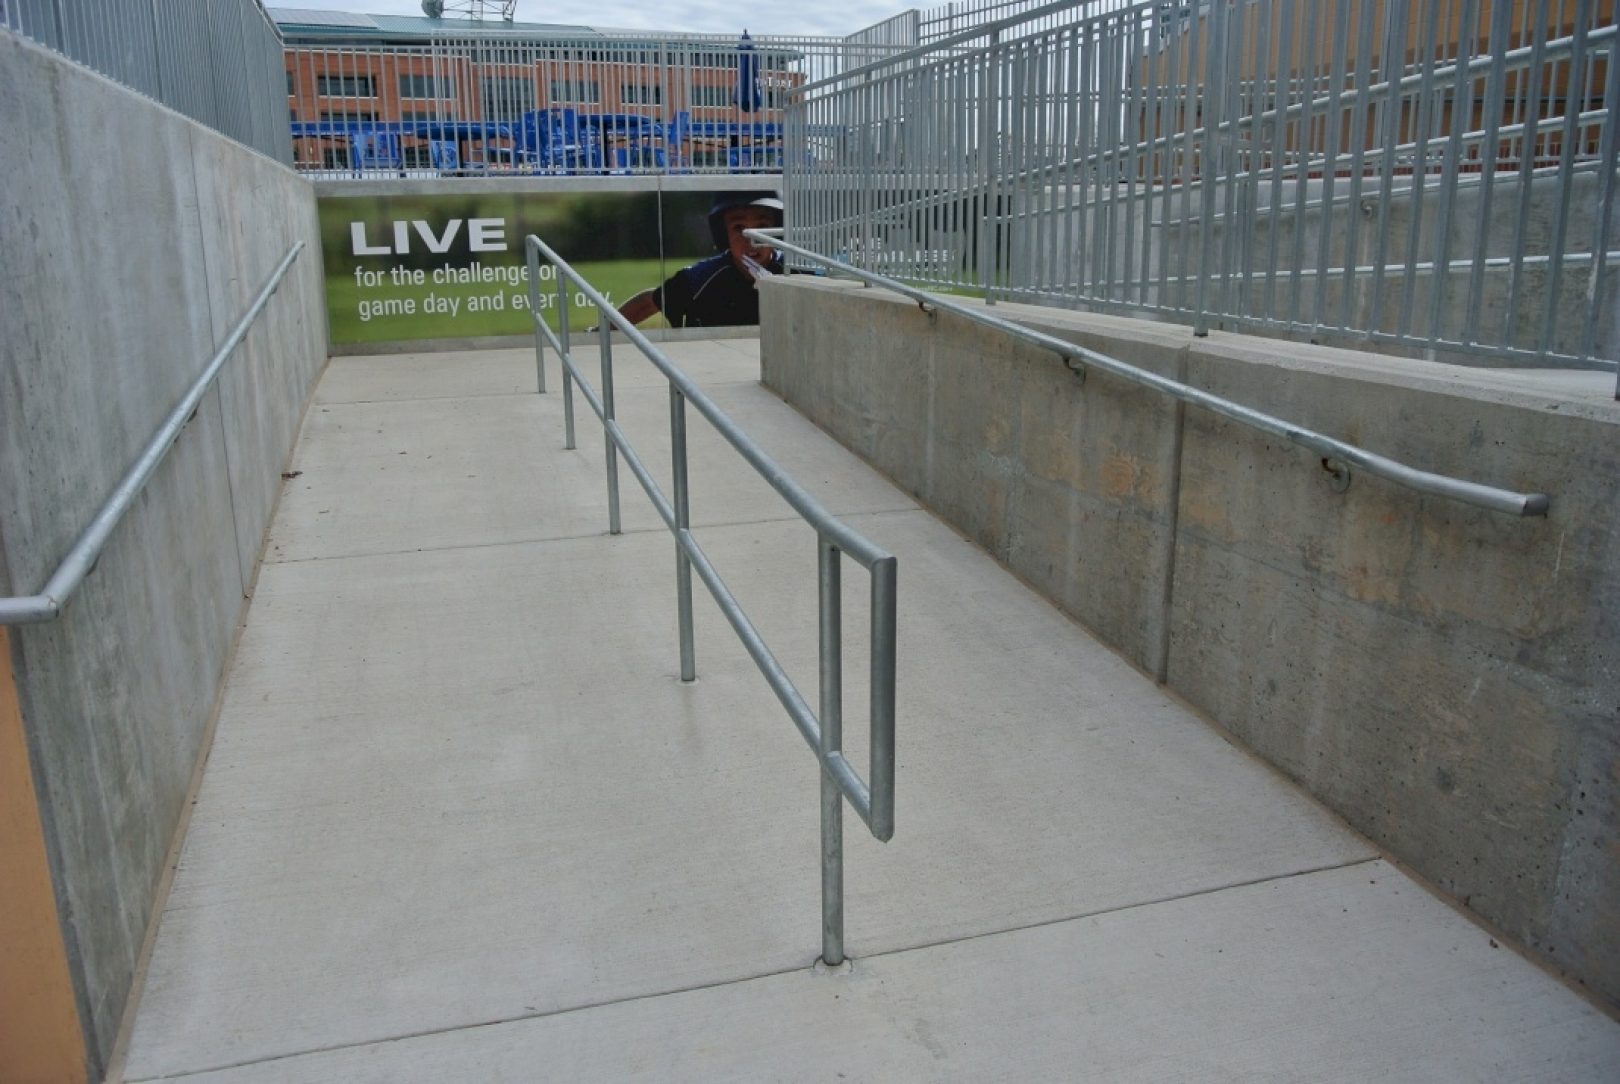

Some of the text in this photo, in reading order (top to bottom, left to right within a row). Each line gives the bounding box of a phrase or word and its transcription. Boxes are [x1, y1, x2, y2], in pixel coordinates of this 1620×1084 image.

[350, 217, 508, 255] LIVE
[354, 265, 385, 287] for
[390, 264, 425, 286] the
[432, 261, 529, 287] challenge
[358, 298, 416, 322] game
[423, 291, 460, 317] day
[467, 290, 504, 312] and
[511, 291, 569, 311] ever
